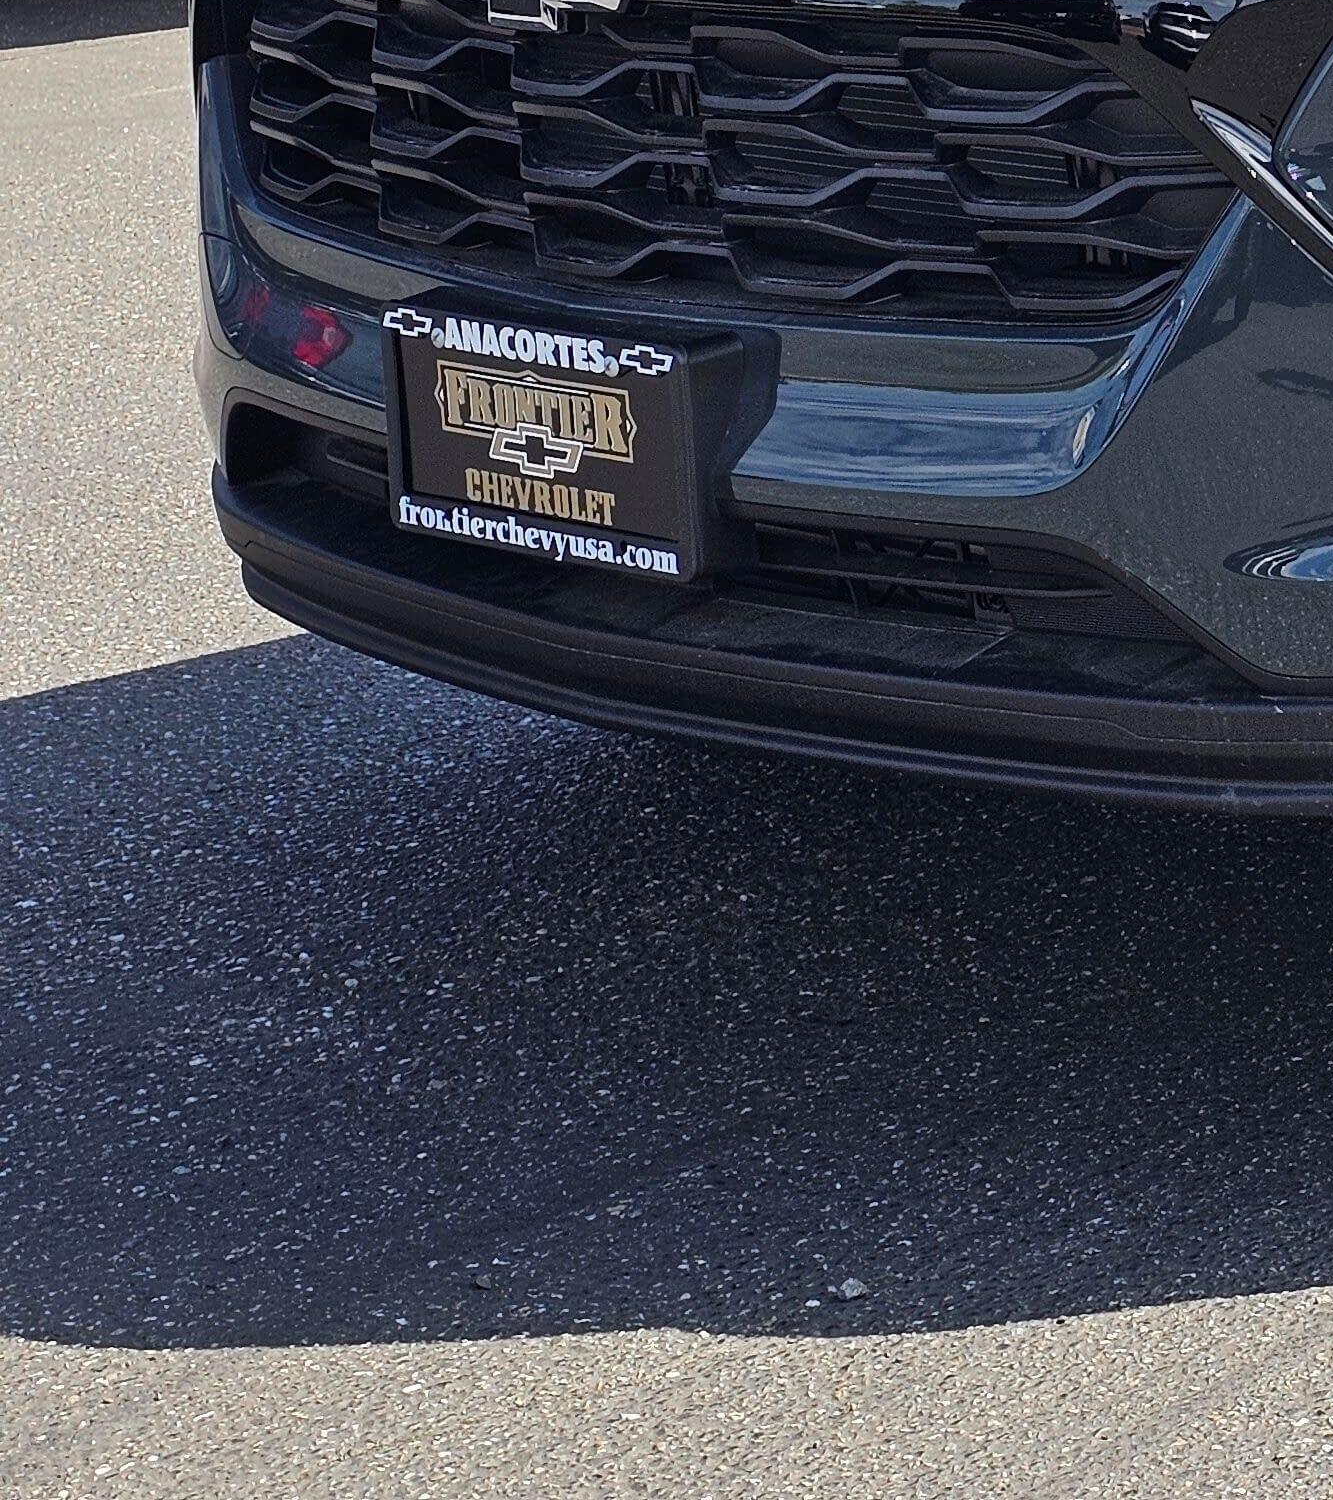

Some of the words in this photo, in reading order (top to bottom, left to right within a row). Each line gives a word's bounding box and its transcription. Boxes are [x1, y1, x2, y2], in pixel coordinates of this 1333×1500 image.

[444, 317, 606, 374] ANACORTES
[444, 368, 628, 452] FRONTIER
[464, 467, 616, 527] CHEVROLET
[398, 496, 680, 575] frontierchevyusa.com
